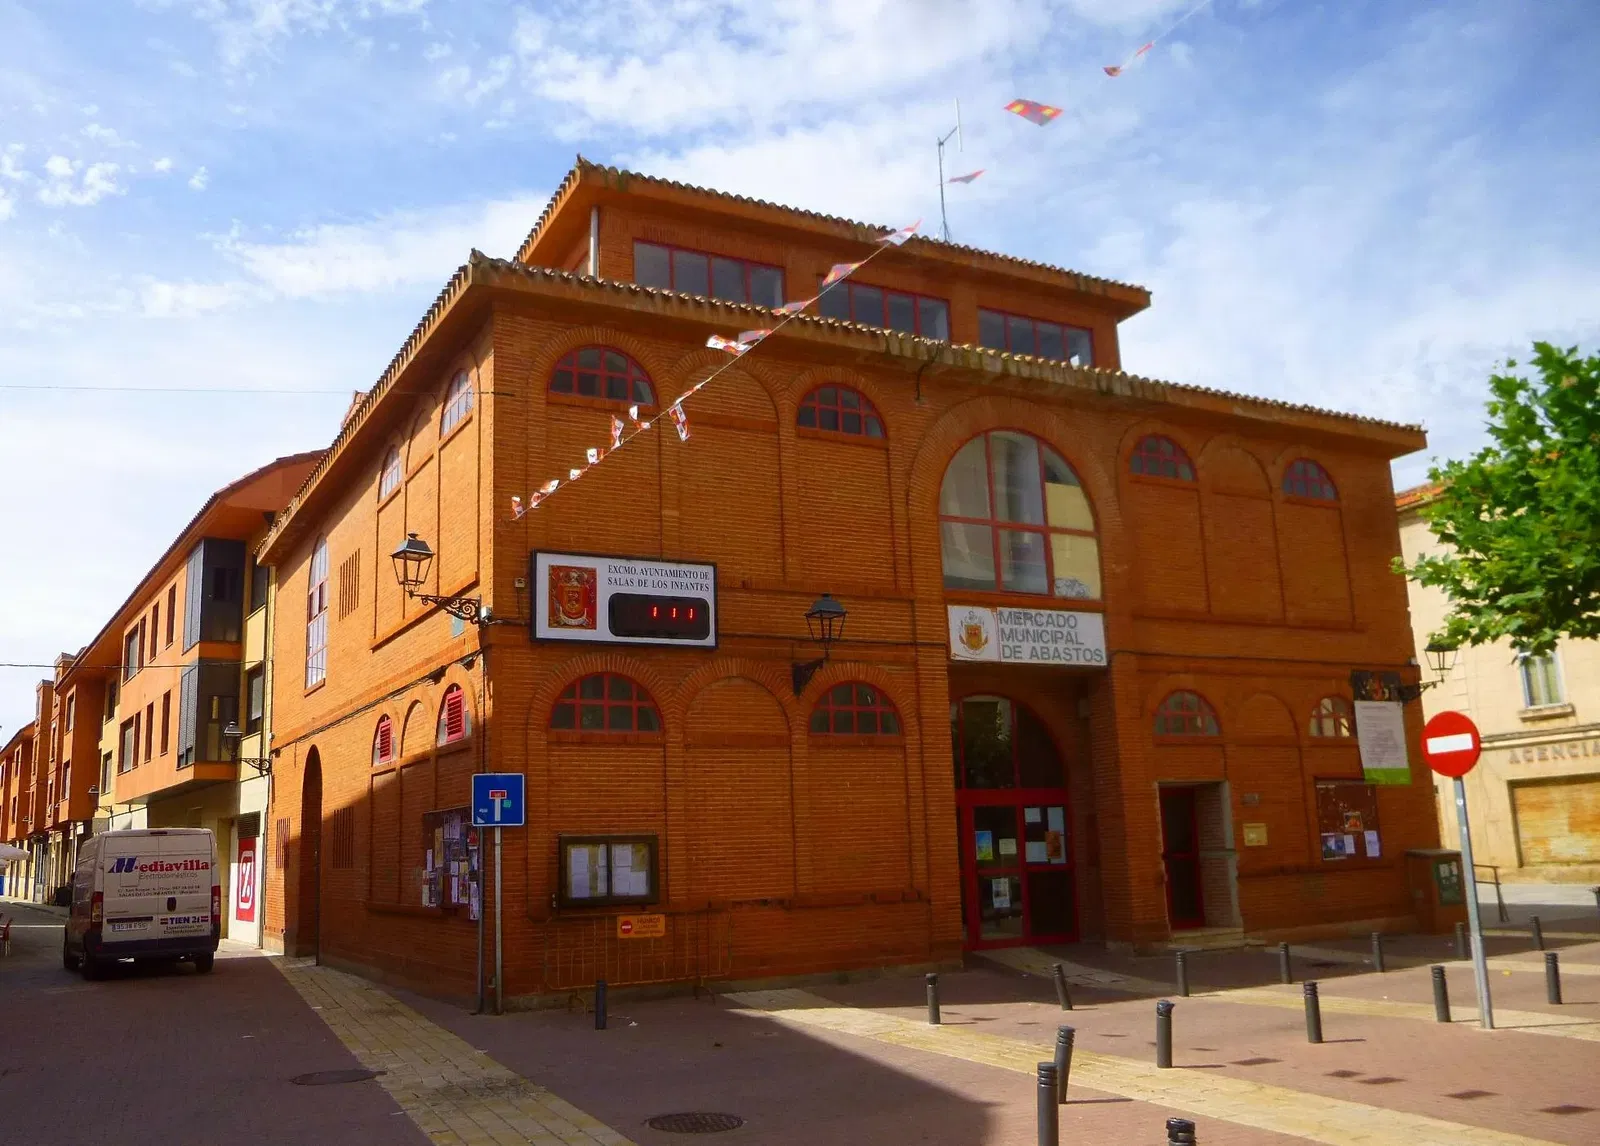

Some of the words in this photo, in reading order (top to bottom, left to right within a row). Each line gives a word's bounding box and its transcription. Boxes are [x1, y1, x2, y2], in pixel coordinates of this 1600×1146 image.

[608, 565, 638, 575] EXCMO.
[640, 567, 699, 580] AYUNTAMIENTO
[699, 571, 710, 580] DE
[607, 577, 634, 587] SALAS
[637, 579, 649, 588] DE
[651, 580, 668, 589] LOS
[671, 581, 710, 592] INFANTES
[999, 611, 1077, 629] MERCADO
[1000, 628, 1085, 646] MUNICIPAL
[1002, 645, 1023, 660] DE
[1029, 645, 1104, 663] ABASTOS
[170, 917, 190, 925] TIEN
